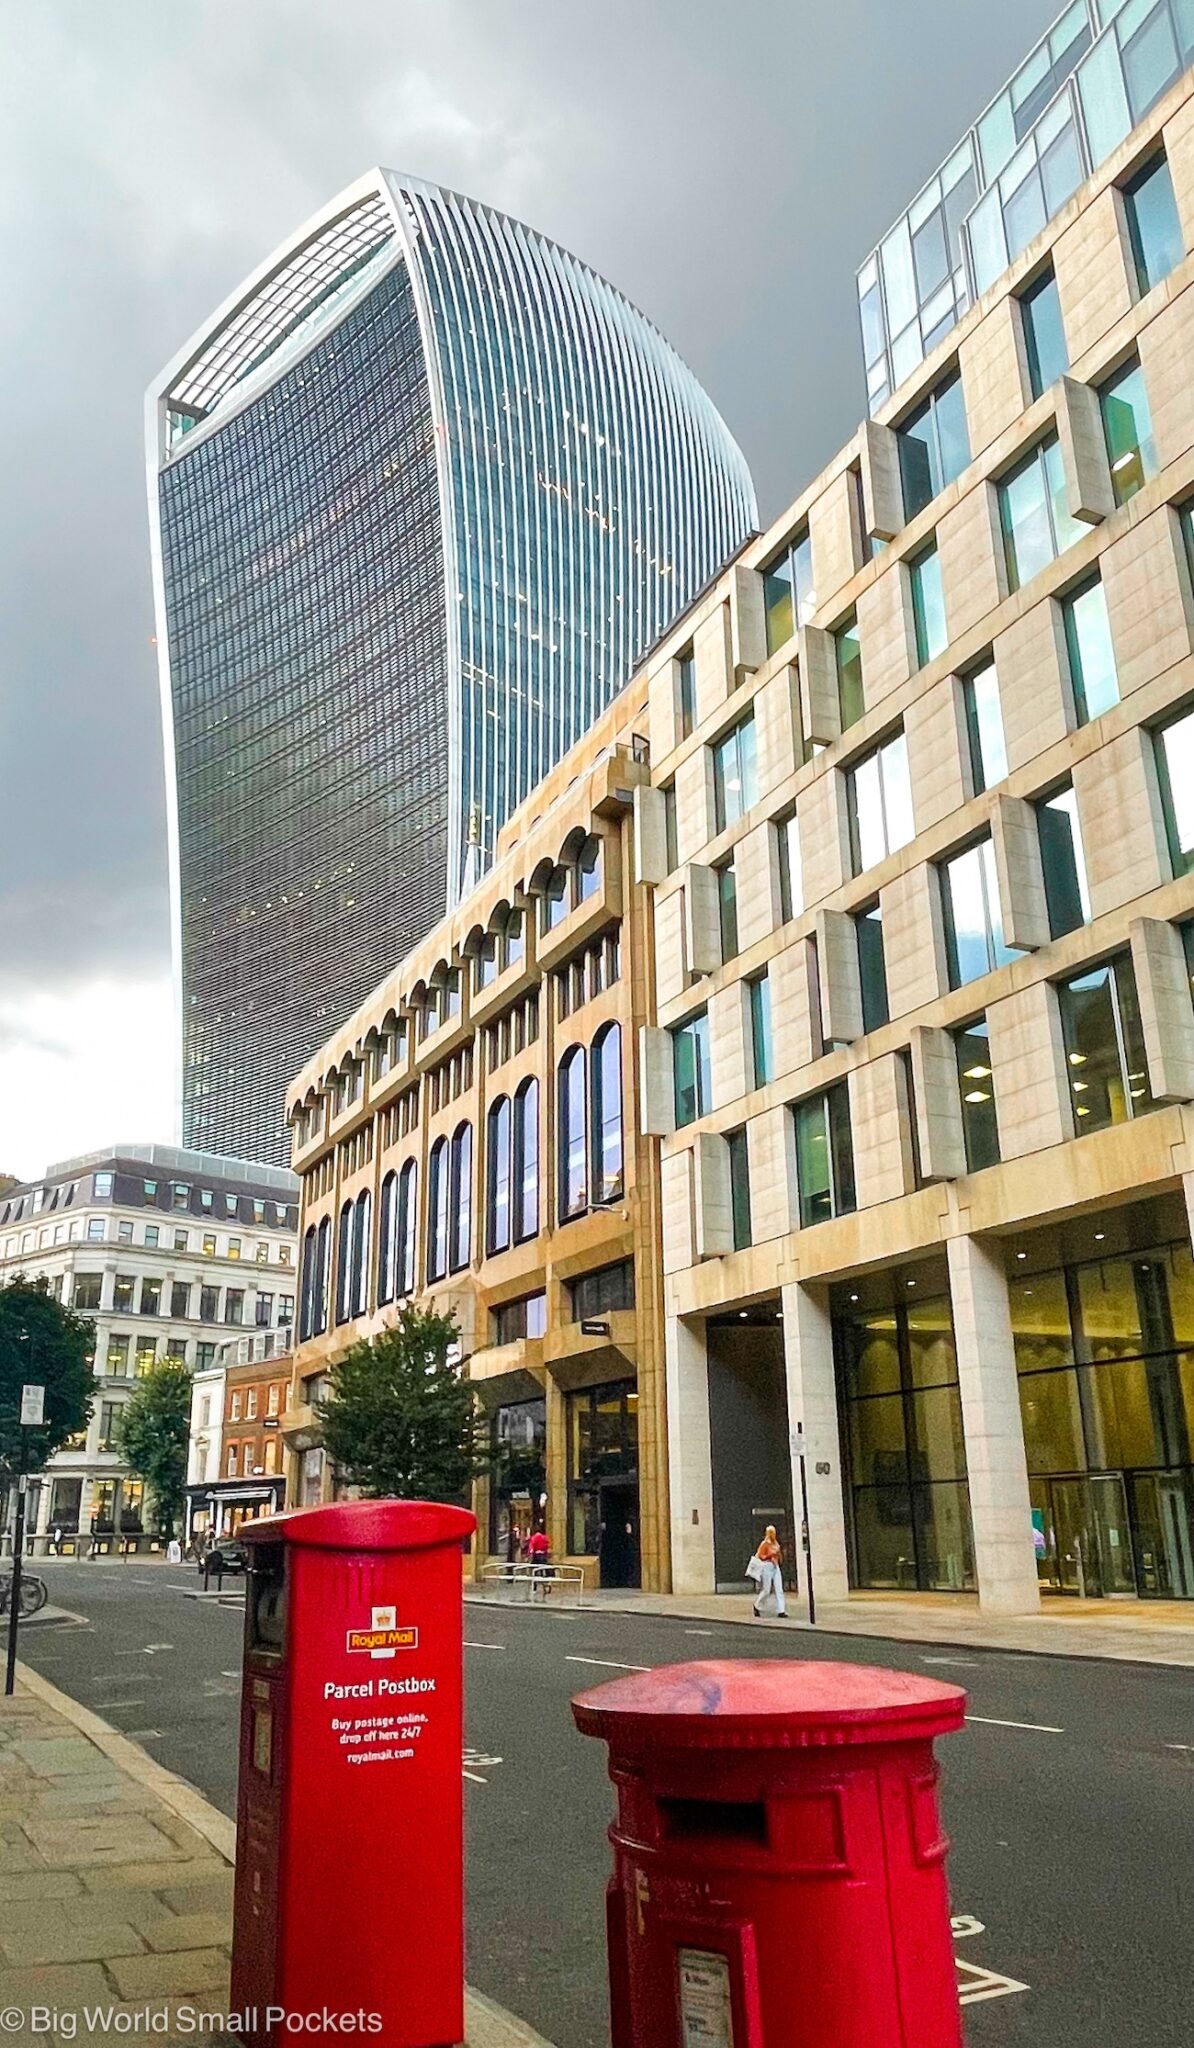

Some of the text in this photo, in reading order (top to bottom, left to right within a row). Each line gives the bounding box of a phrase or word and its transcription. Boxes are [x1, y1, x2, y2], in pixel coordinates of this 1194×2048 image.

[351, 1631, 414, 1648] Royal Mail
[324, 1677, 436, 1699] Parcel Postbox
[331, 1718, 352, 1731] Buy
[354, 1715, 394, 1730] postage
[339, 1726, 422, 1745] drop off here 24/7
[347, 1748, 414, 1765] royalmail.com
